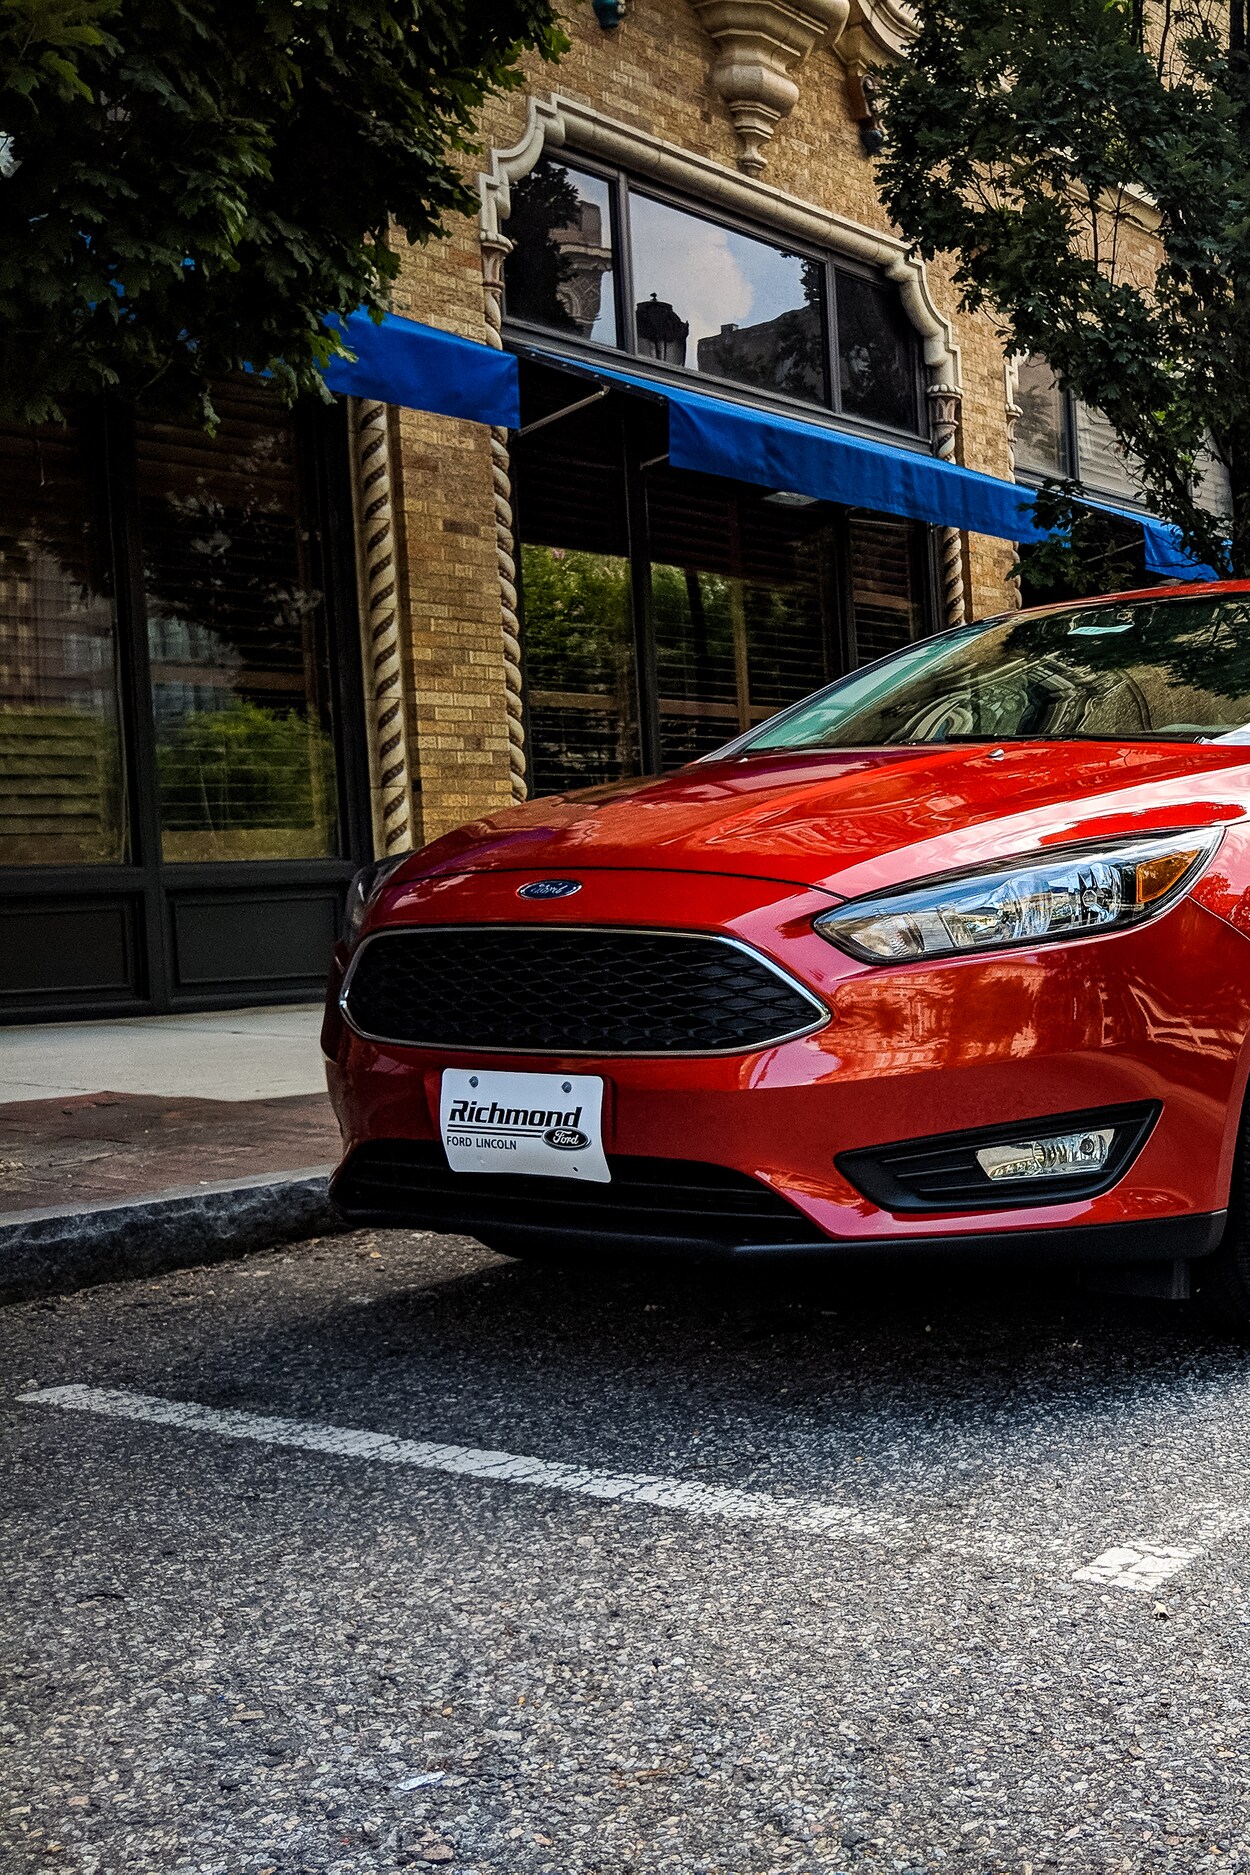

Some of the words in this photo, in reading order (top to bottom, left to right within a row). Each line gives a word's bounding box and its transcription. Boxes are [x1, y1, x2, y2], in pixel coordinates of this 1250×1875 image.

[449, 1099, 583, 1128] Richmond
[446, 1135, 472, 1147] FORD
[476, 1137, 517, 1150] LINCOLN
[552, 1129, 580, 1145] Ford
